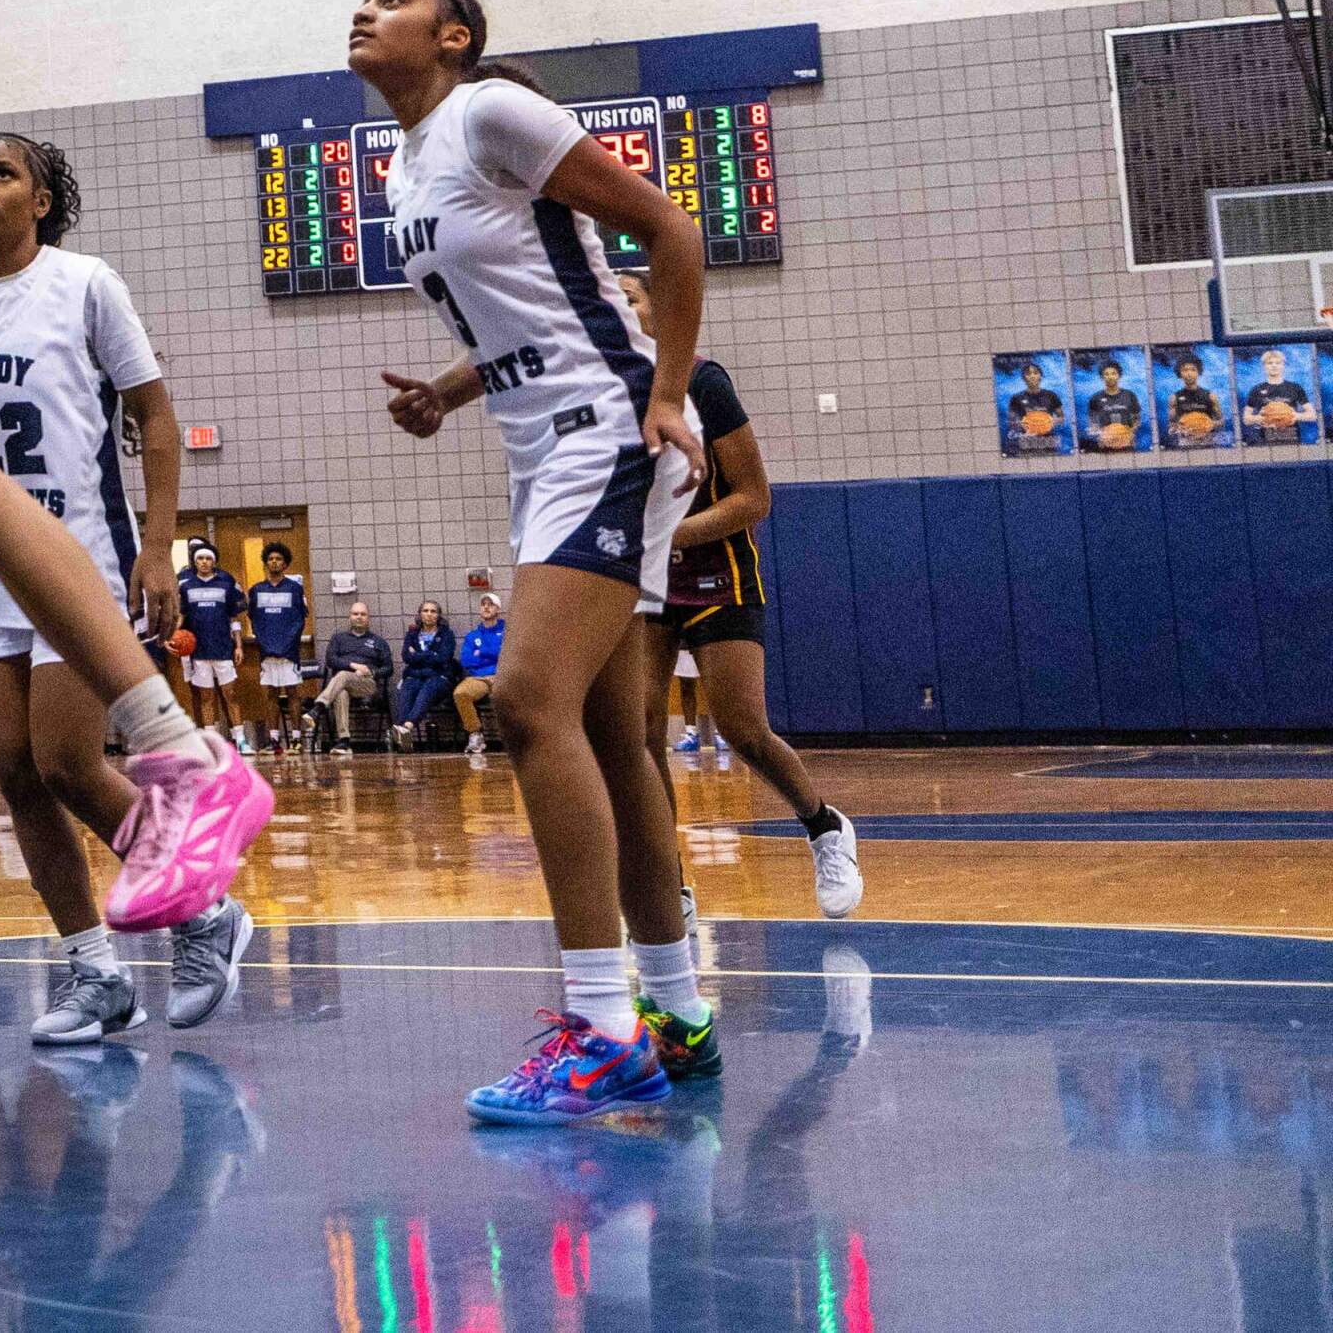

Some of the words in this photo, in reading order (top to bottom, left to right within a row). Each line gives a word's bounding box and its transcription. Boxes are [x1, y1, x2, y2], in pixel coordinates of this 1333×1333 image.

[666, 95, 686, 109] NO
[581, 106, 654, 129] VISITOR
[684, 111, 692, 131] 1
[715, 107, 730, 129] 3
[751, 104, 766, 125] 8
[261, 134, 278, 147] NO
[680, 137, 695, 158] 3
[717, 134, 732, 155] 2
[754, 131, 768, 151] 5
[270, 147, 283, 167] 3
[310, 144, 318, 165] 1
[324, 142, 349, 162] 20
[265, 172, 284, 193] 12
[305, 169, 318, 191] 2
[338, 167, 351, 186] 0
[667, 163, 696, 186] 22
[719, 161, 734, 183] 3
[756, 158, 770, 178] 6
[267, 196, 286, 217] 13
[341, 192, 352, 211] 3
[720, 187, 737, 209] 3
[751, 183, 773, 206] 11
[268, 222, 288, 243] 15
[308, 220, 321, 241] 3
[341, 218, 354, 236] 4
[724, 214, 739, 235] 2
[760, 211, 774, 231] 2
[263, 248, 289, 269] 22
[310, 245, 322, 266] 2
[343, 243, 355, 262] 0
[190, 426, 214, 447] EXIT
